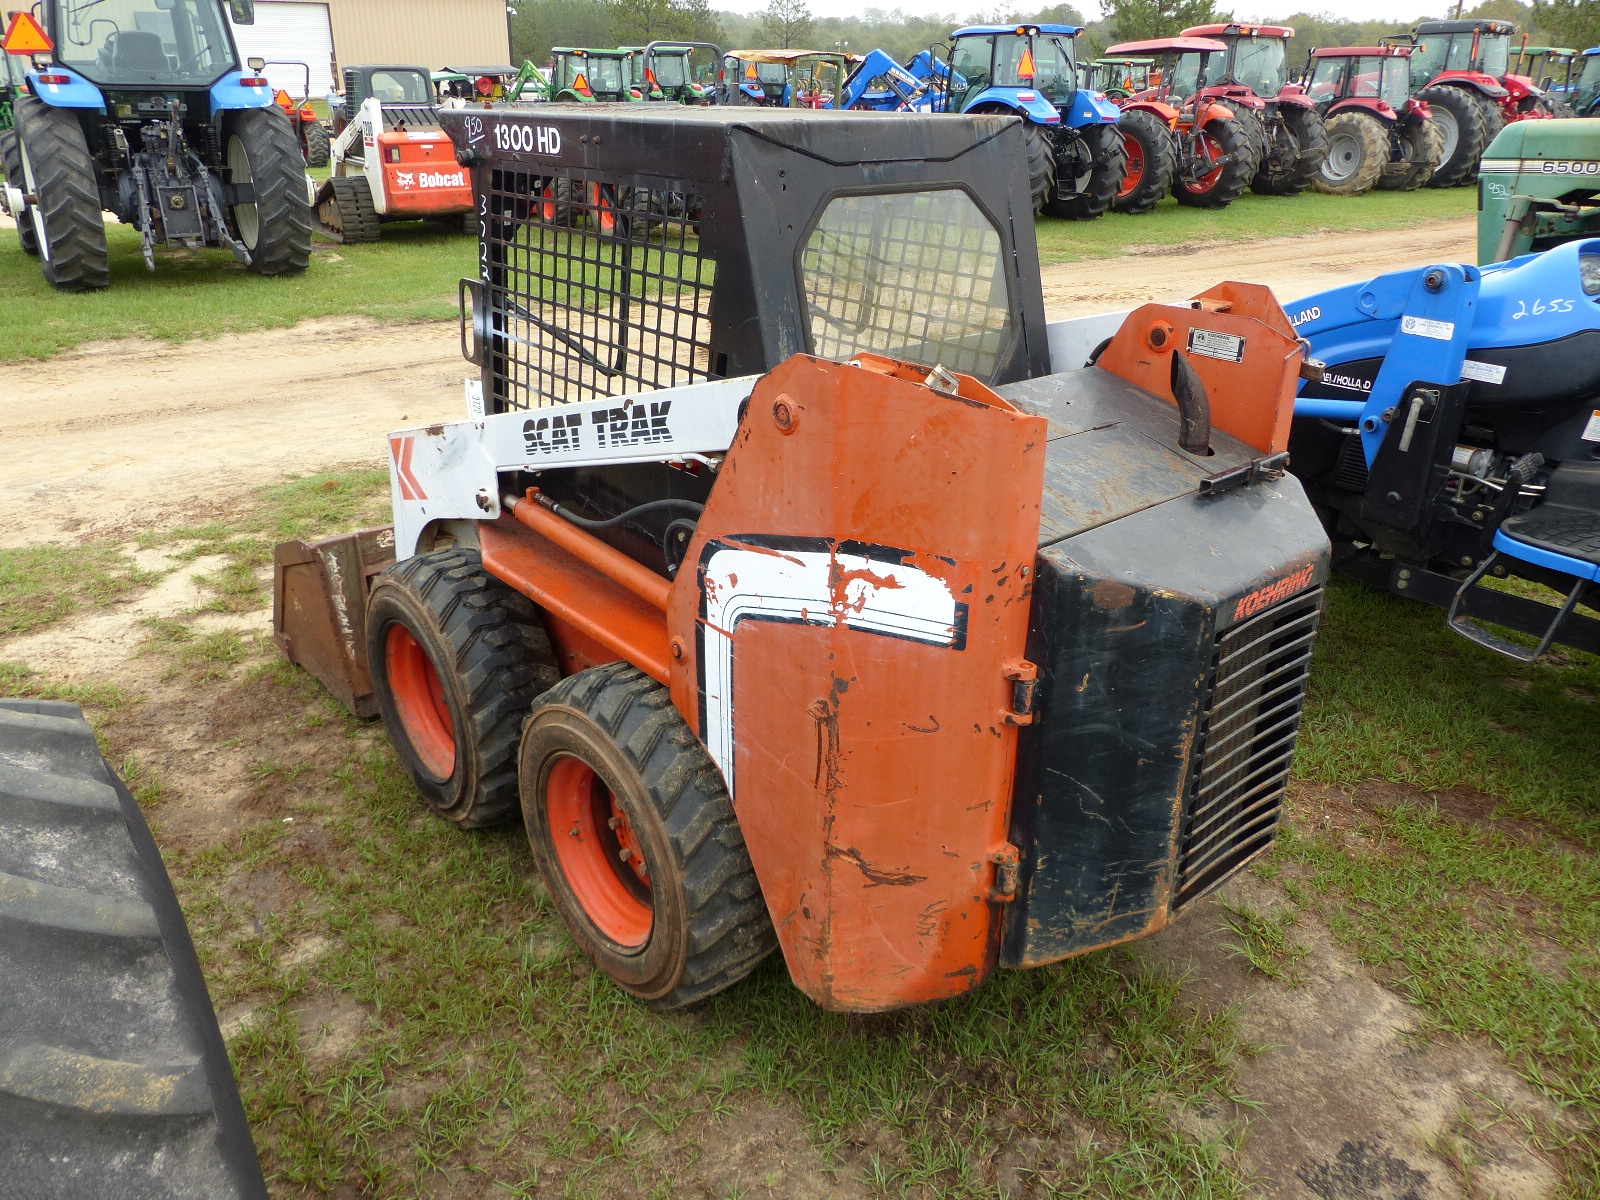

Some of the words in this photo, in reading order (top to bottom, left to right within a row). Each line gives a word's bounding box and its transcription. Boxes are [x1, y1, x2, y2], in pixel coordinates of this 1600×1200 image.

[464, 116, 483, 138] 950
[494, 123, 534, 152] 1300
[537, 126, 561, 154] HD
[1542, 161, 1599, 173] 6500
[419, 171, 464, 188] Bobcat
[1488, 182, 1510, 196] 952
[1288, 306, 1321, 327] LLAND
[1512, 298, 1576, 320] 2655
[523, 413, 582, 456] SCAT
[591, 400, 674, 449] TRAK
[1233, 563, 1315, 621] KOEHRING
